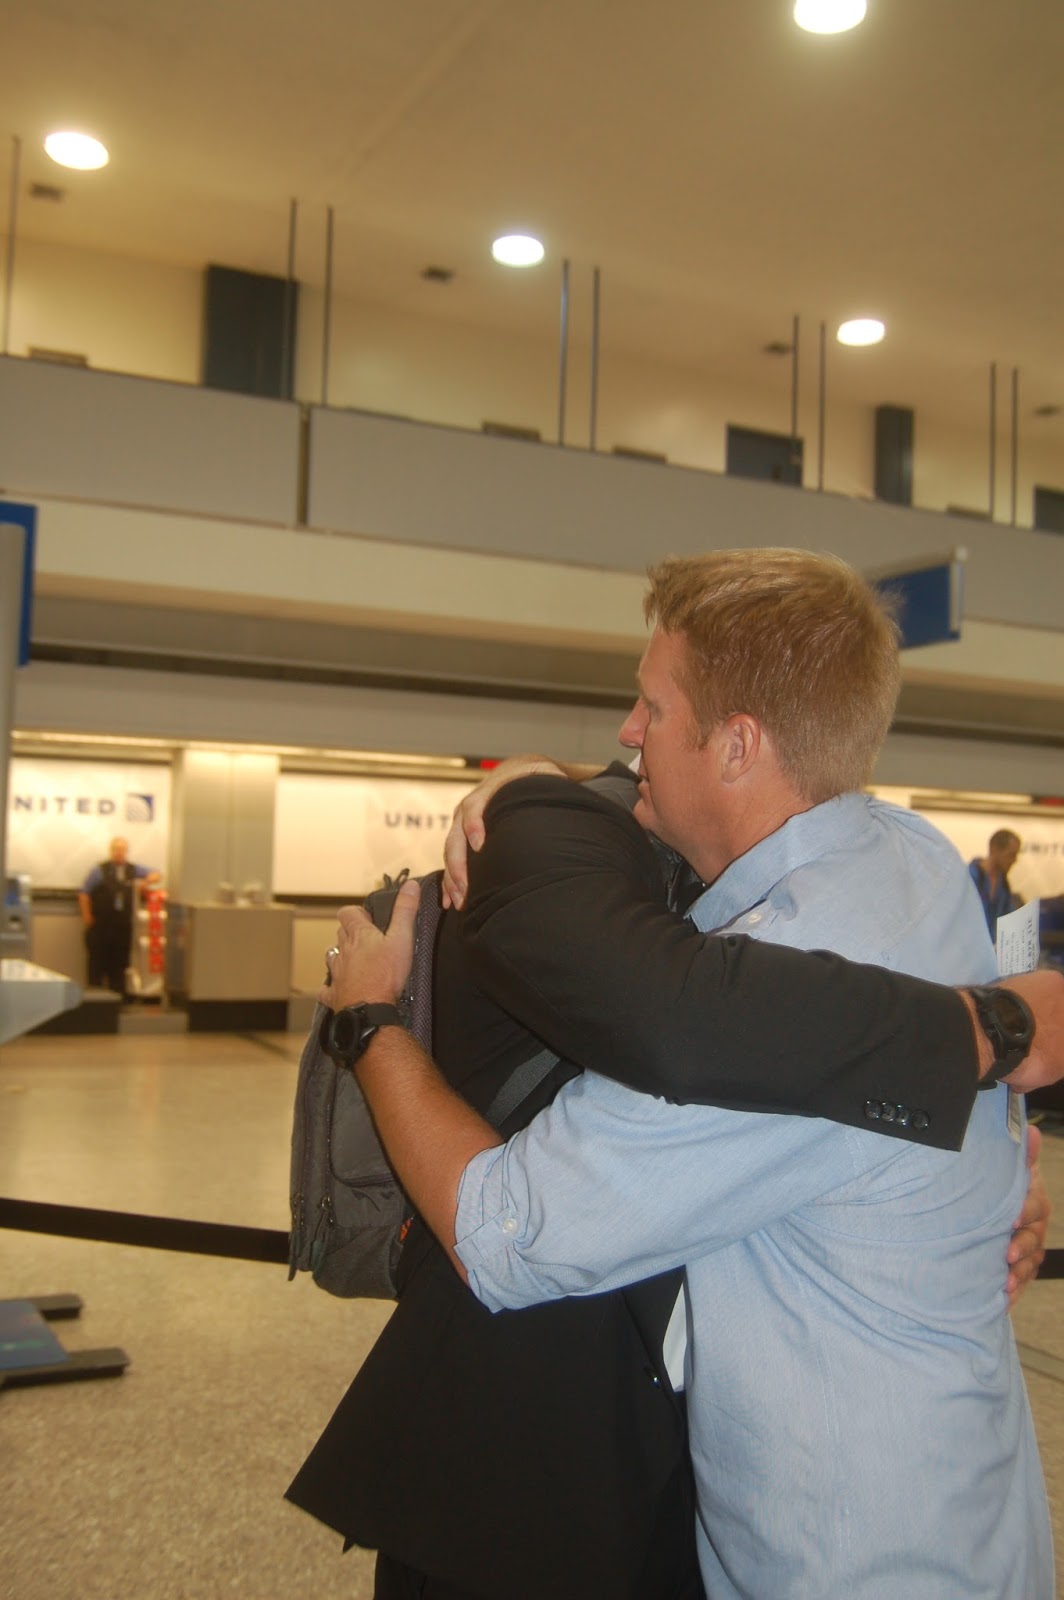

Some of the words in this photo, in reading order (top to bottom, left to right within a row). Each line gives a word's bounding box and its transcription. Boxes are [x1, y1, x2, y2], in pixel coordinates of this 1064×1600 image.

[14, 796, 116, 815] NITED
[384, 811, 450, 829] UNIT
[1020, 842, 1064, 857] UNIT
